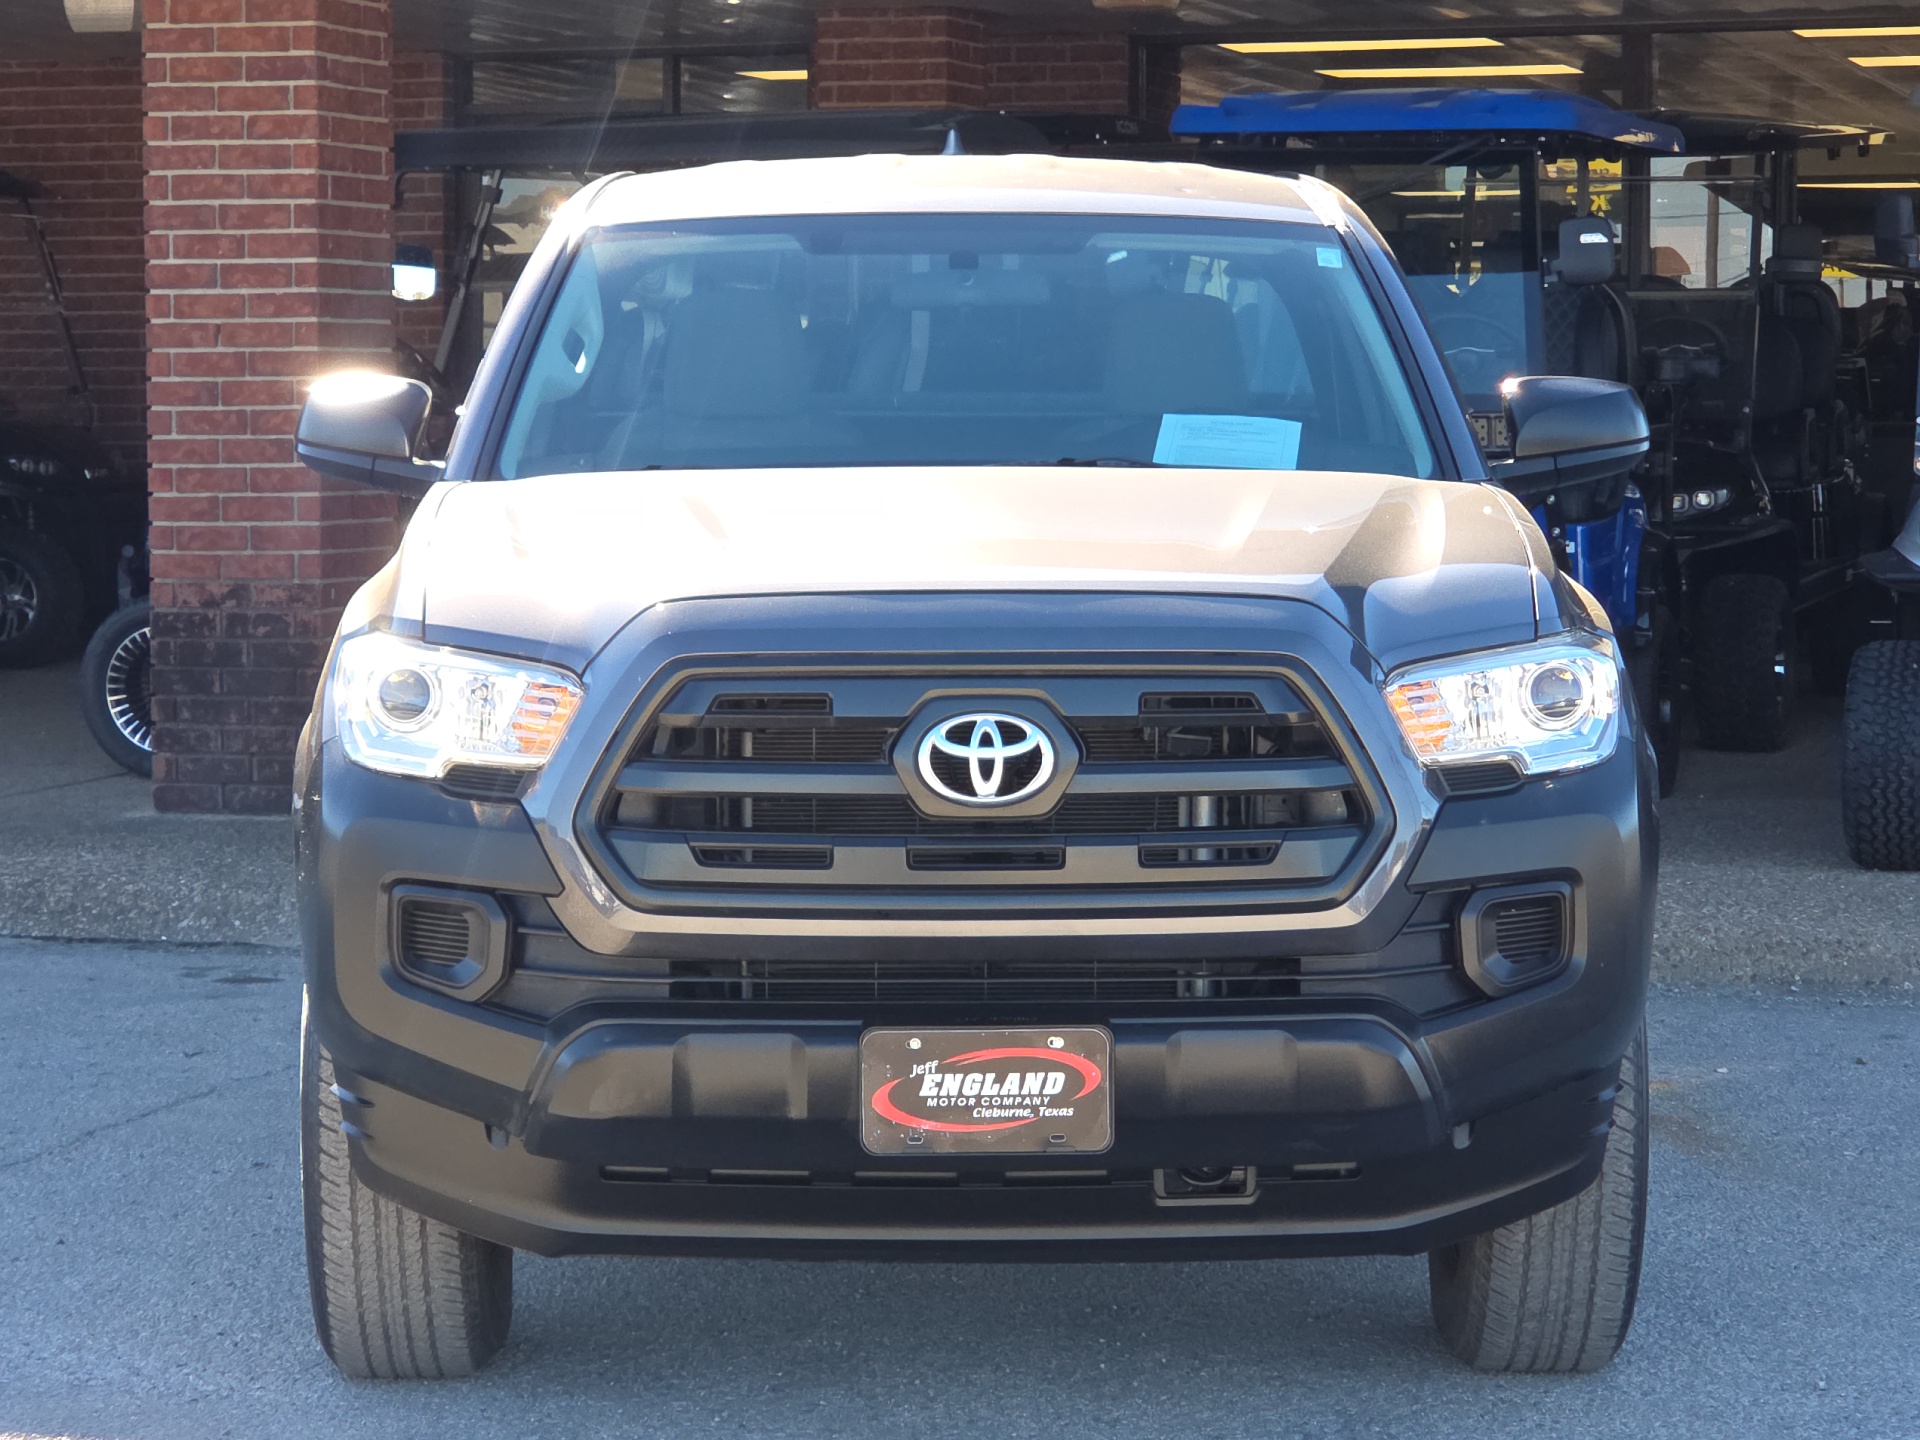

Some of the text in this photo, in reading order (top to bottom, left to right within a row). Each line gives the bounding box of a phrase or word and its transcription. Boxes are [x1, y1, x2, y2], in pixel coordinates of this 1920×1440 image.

[909, 1060, 939, 1078] Jeff
[919, 1071, 1066, 1097] ENGLAND
[926, 1096, 1050, 1107] MOTOR COMPANY
[972, 1106, 1075, 1118] Cleburne, Texas
